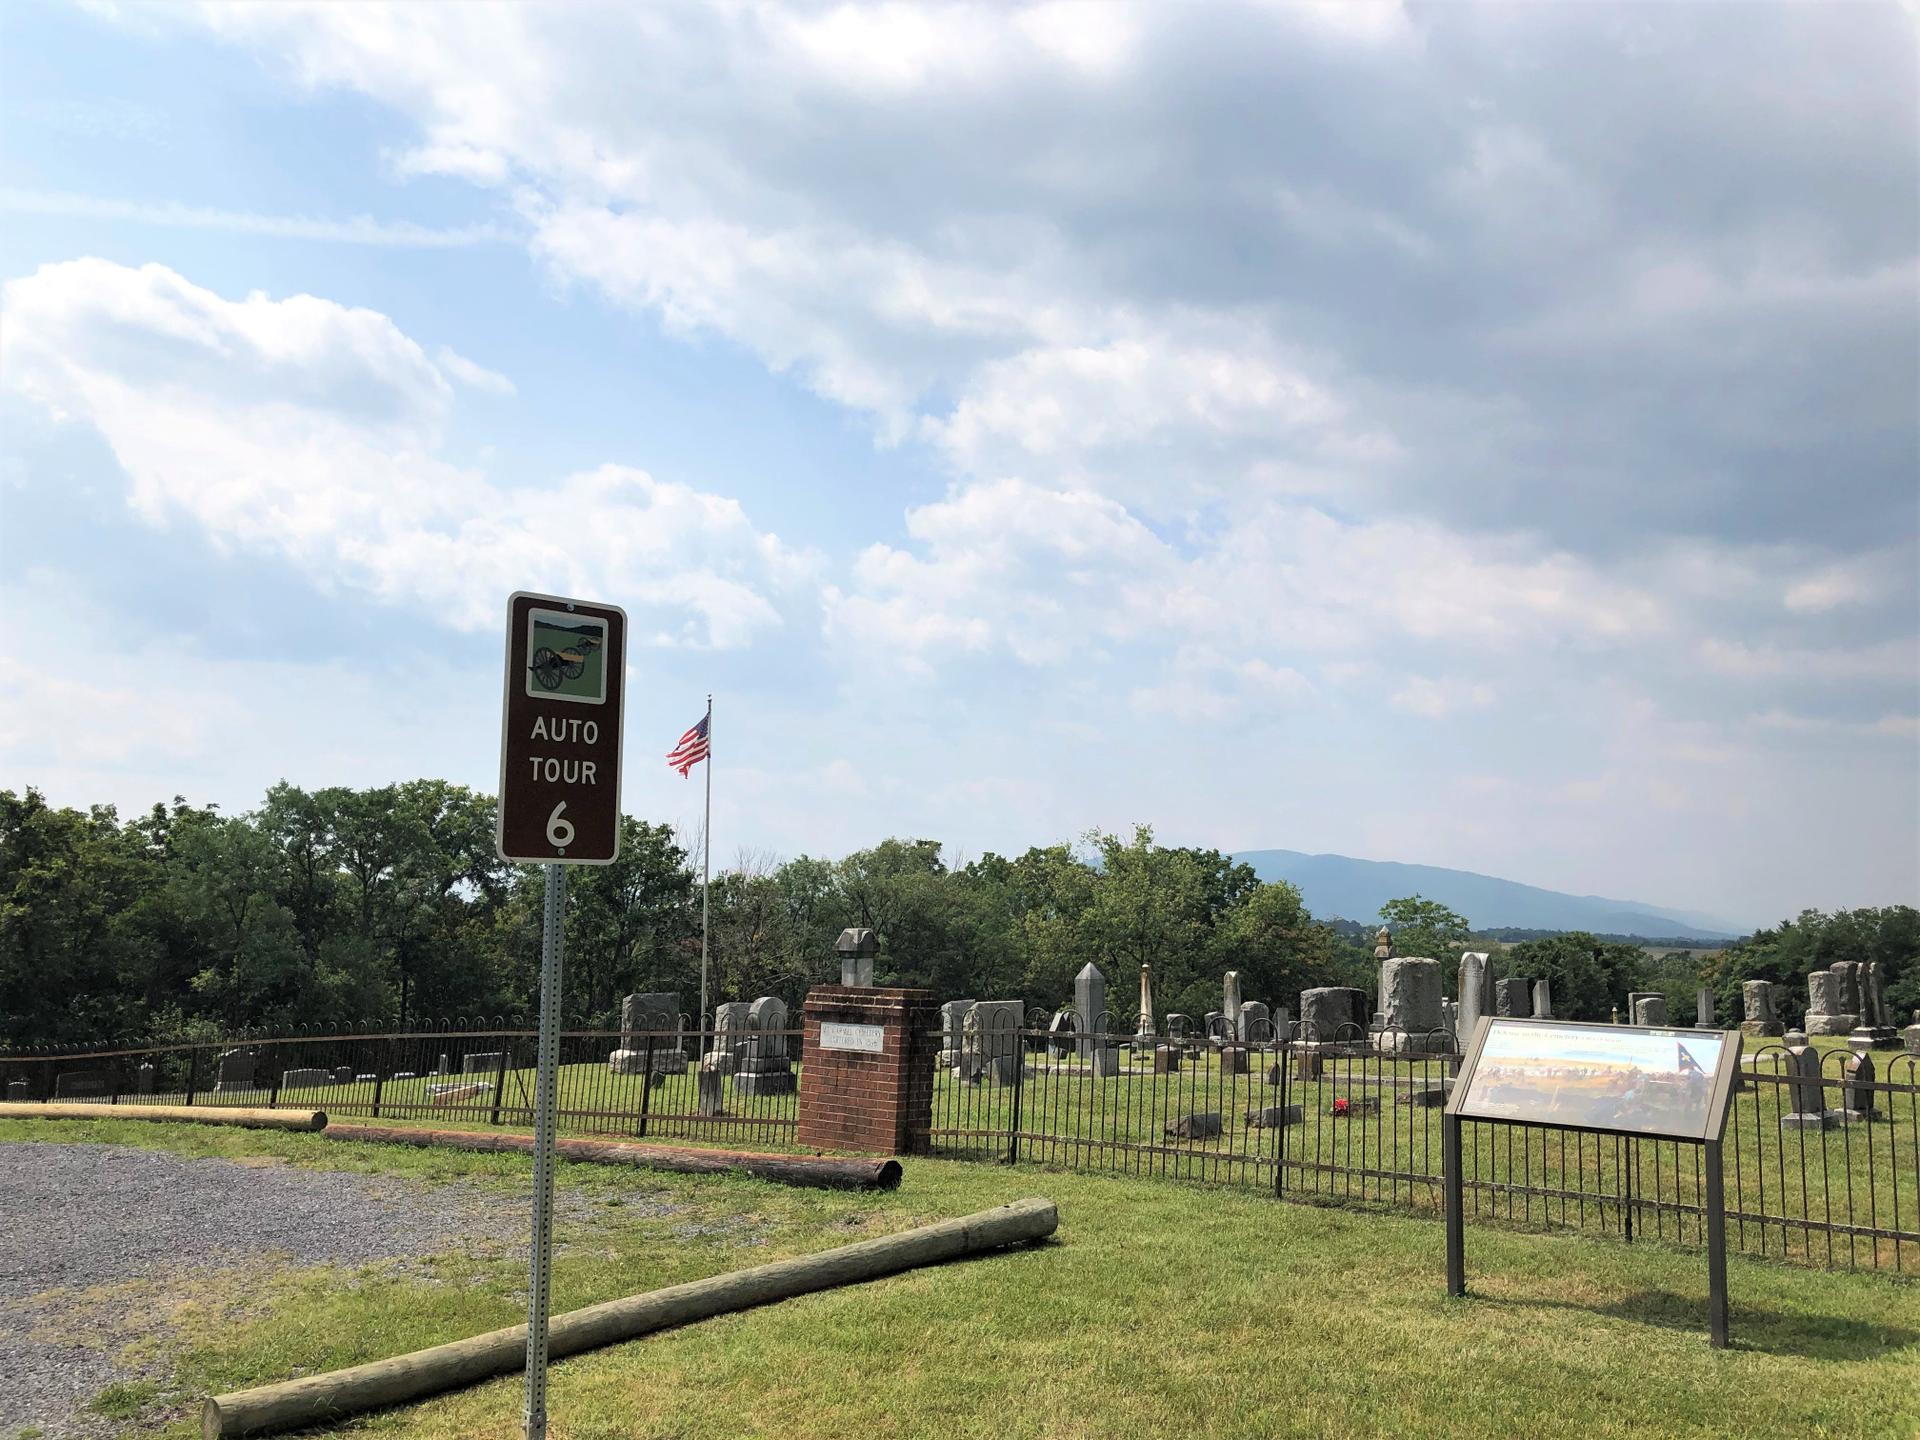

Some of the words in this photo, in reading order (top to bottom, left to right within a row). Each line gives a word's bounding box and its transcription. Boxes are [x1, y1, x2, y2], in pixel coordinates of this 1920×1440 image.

[530, 716, 598, 745] AUTO
[529, 757, 597, 785] TOUR
[546, 800, 575, 848] 6
